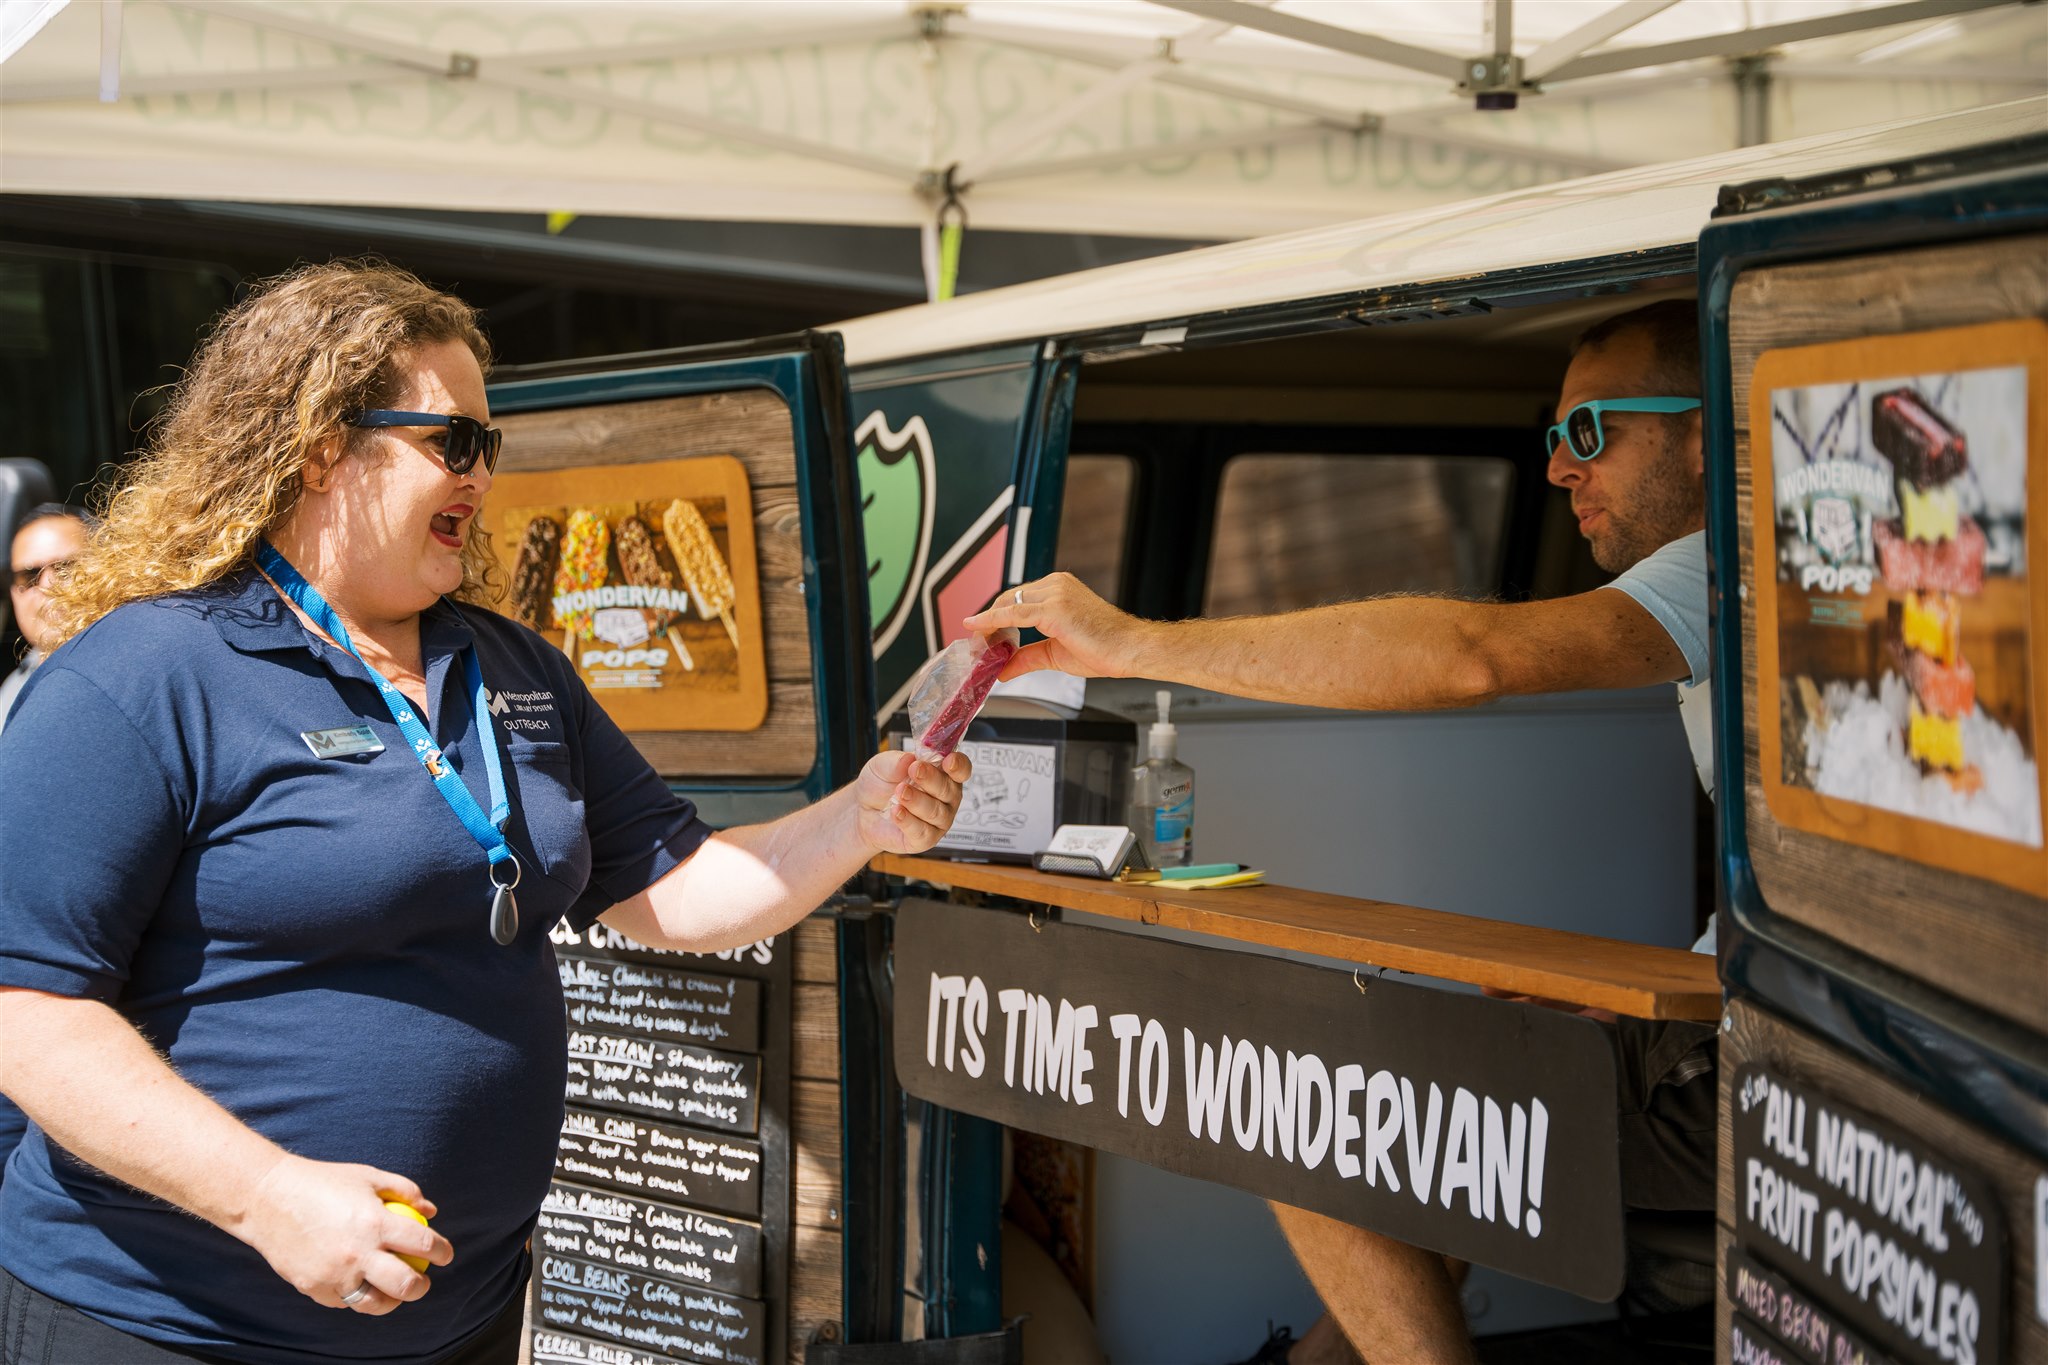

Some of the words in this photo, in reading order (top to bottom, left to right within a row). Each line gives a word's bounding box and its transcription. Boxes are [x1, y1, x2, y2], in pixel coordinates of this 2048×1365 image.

[1782, 460, 1889, 502] WONDERVAN
[1802, 565, 1873, 596] POPS
[552, 585, 689, 616] WONDERVAN
[582, 649, 669, 668] POPS
[502, 689, 554, 706] Metropolitan
[503, 718, 551, 731] OUTREACH
[956, 810, 1029, 830] OPS
[707, 1001, 731, 1015] and
[568, 1031, 597, 1054] AST
[598, 1036, 656, 1064] STRAW
[667, 1049, 744, 1081] Strawberry
[592, 1085, 626, 1102] with
[628, 1090, 674, 1111] rainbow
[635, 1068, 650, 1083] in
[653, 1071, 689, 1089] white
[693, 1076, 747, 1099] chocolate
[926, 971, 988, 1079] ITS
[999, 988, 1099, 1106] TIME
[1110, 1013, 1170, 1127] TO
[1184, 1027, 1549, 1240] WONDERVAN!
[650, 1129, 684, 1150] Brown
[687, 1137, 718, 1158] sugar
[614, 1165, 644, 1186] toast
[647, 1176, 689, 1195] crunch
[624, 1147, 637, 1161] in
[641, 1150, 689, 1170] chocolate
[691, 1161, 714, 1175] and
[716, 1161, 751, 1182] topped
[1763, 1082, 1809, 1168] ALL
[1816, 1107, 1949, 1252] NATURAL
[578, 1192, 637, 1218] Monster
[645, 1205, 684, 1232] Cookies
[543, 1231, 580, 1252] topped
[585, 1238, 611, 1259] Oreo
[615, 1245, 648, 1268] Cookie
[554, 1217, 589, 1234] cream
[593, 1219, 631, 1244] Dipped
[634, 1228, 647, 1248] in
[651, 1232, 706, 1257] Chocolate
[713, 1244, 738, 1263] and
[1747, 1157, 1819, 1262] FRUIT
[1823, 1206, 1980, 1365] POPSICLES
[542, 1256, 581, 1284] COOL
[583, 1265, 631, 1297] BEANS
[642, 1281, 680, 1306] Coffee
[626, 1304, 639, 1318] in
[640, 1307, 684, 1326] chocolate
[689, 1318, 713, 1332] and
[1736, 1266, 1778, 1323] MIXED
[1780, 1293, 1830, 1363] BERRY
[534, 1332, 585, 1357] CEREAL
[588, 1343, 634, 1365] KILLER
